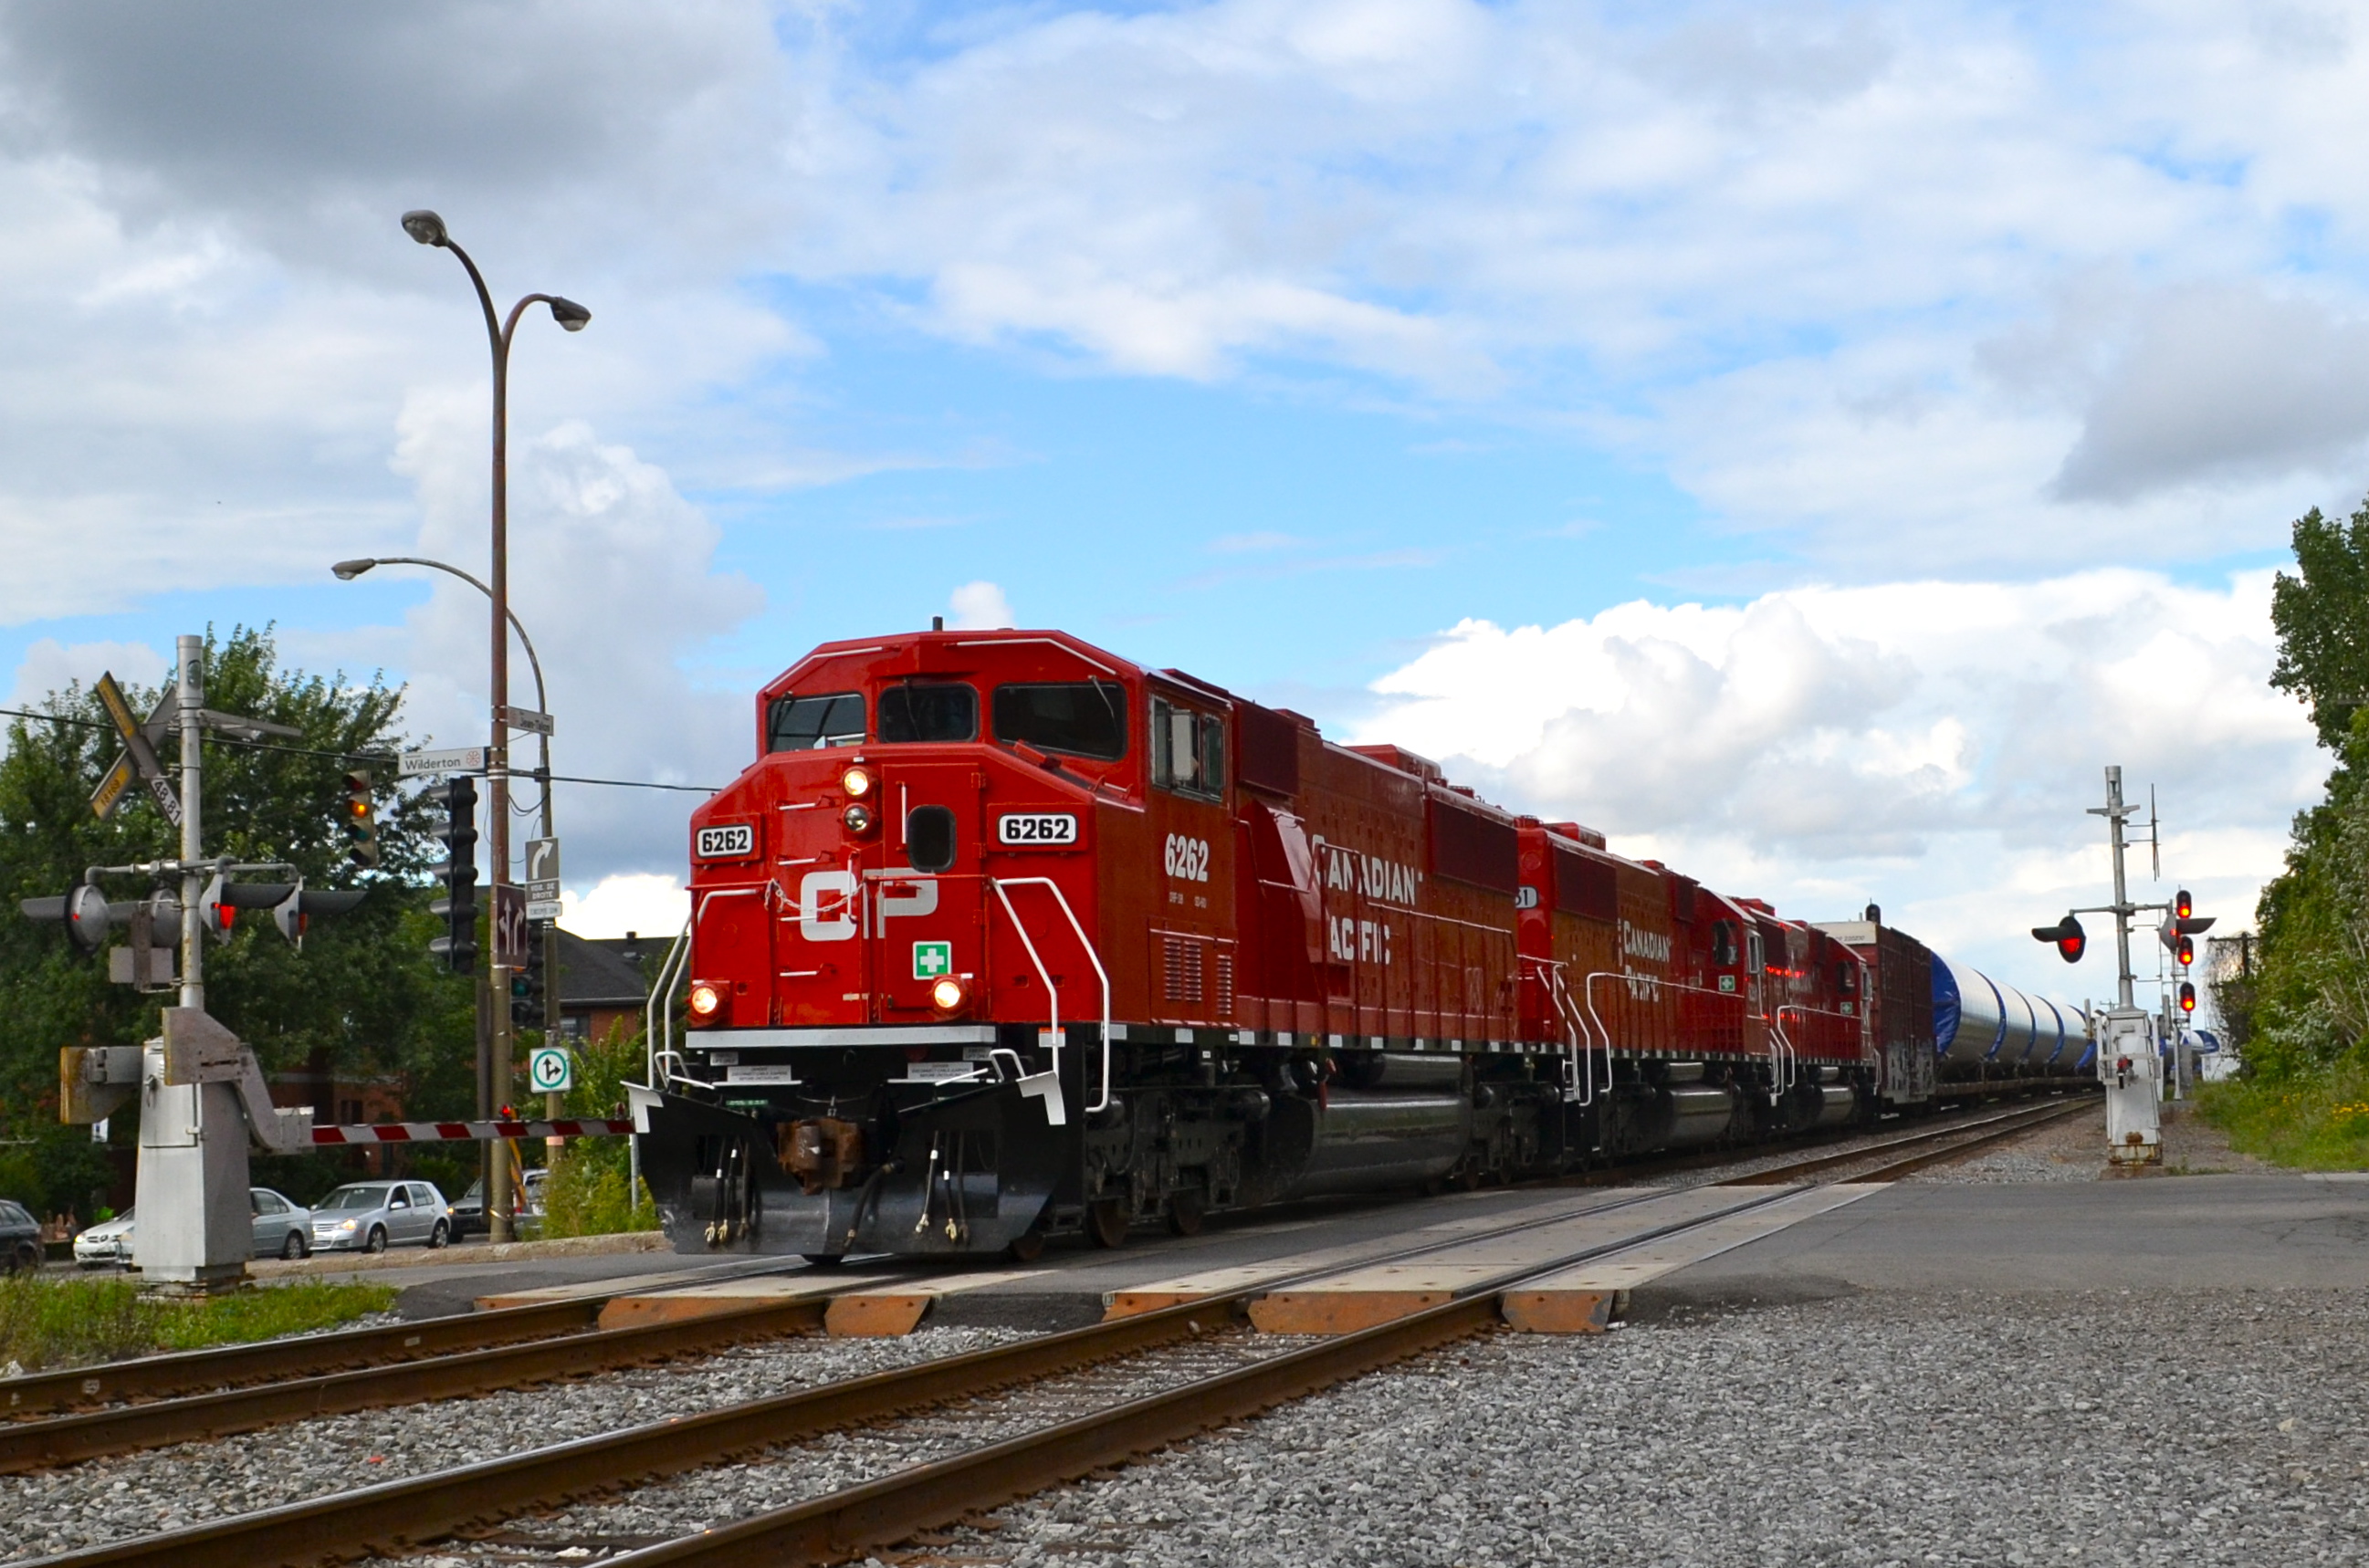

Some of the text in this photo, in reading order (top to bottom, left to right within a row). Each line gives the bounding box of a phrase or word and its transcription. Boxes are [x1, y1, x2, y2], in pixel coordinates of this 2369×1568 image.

[404, 758, 461, 770] Wilderton
[153, 780, 182, 822] 48.81
[700, 828, 748, 853] 6262
[1005, 819, 1070, 841] 6262
[1164, 832, 1209, 883] 6262
[801, 867, 938, 942] CP
[1623, 920, 1670, 963] CANADIAN
